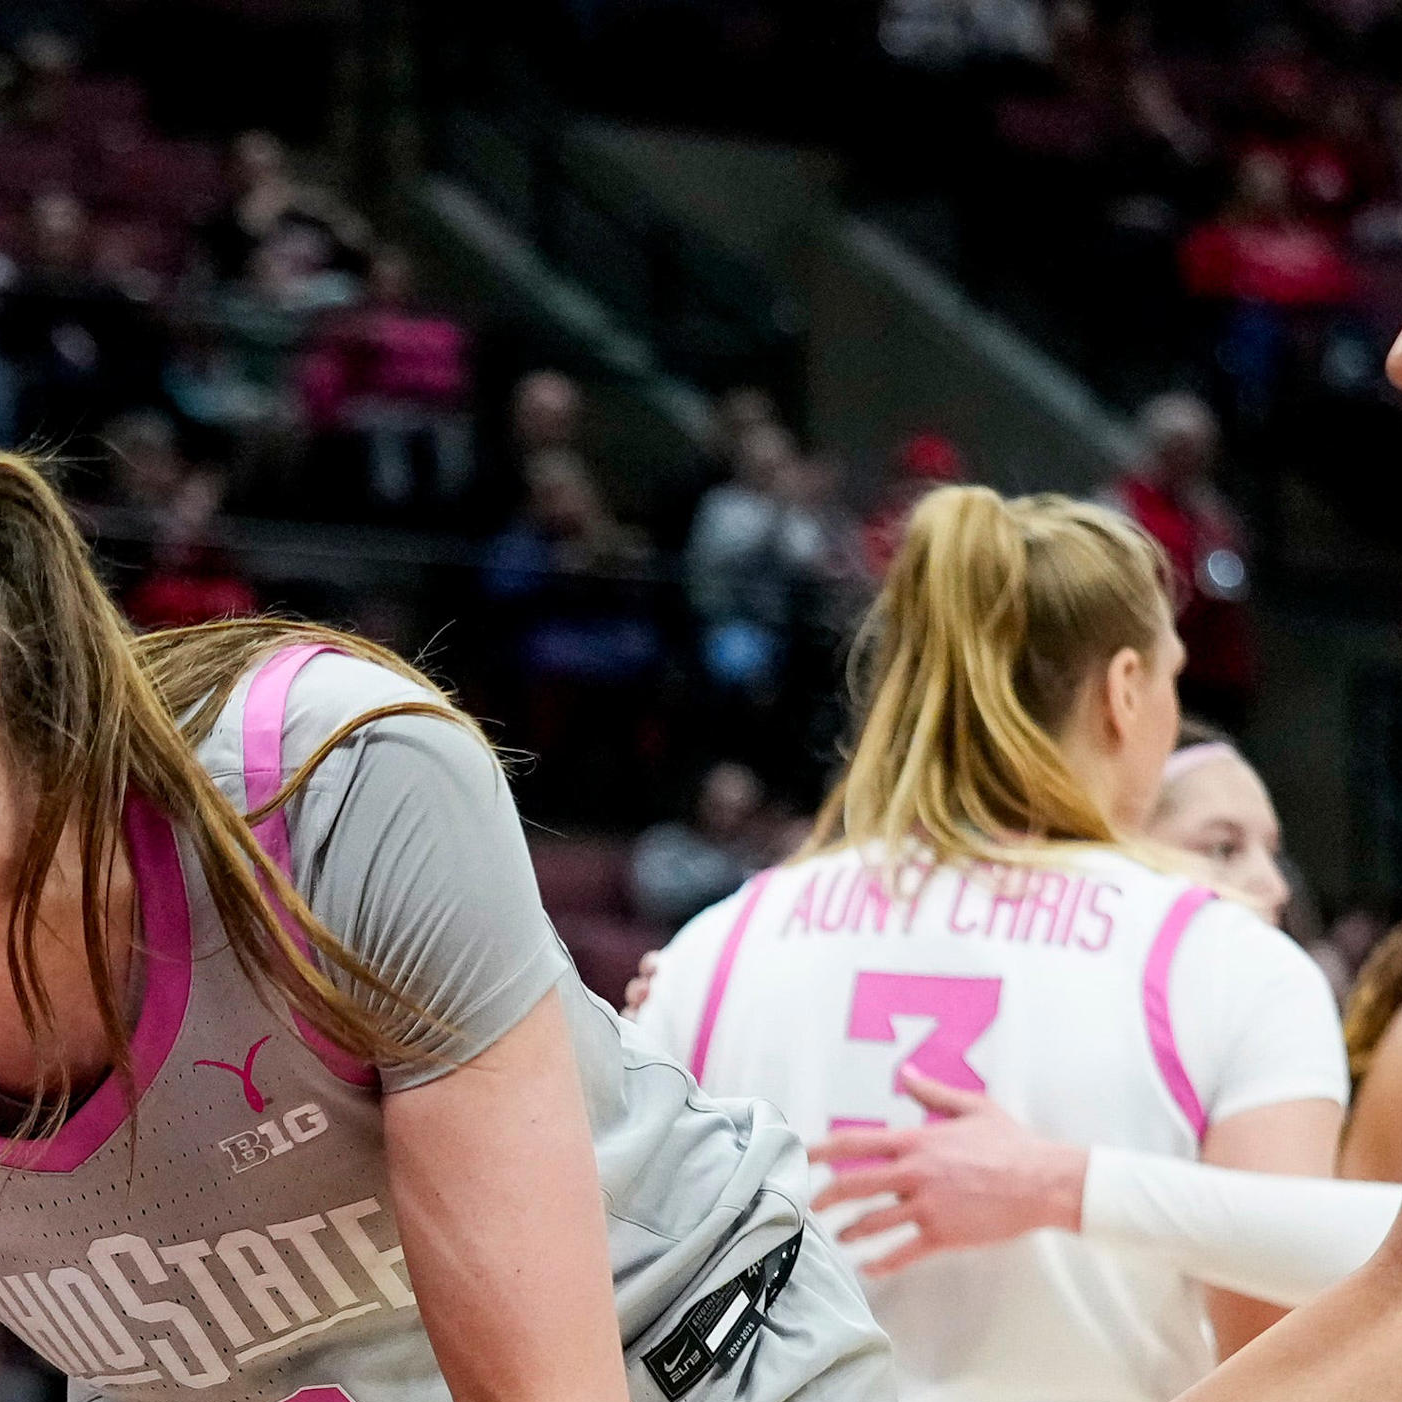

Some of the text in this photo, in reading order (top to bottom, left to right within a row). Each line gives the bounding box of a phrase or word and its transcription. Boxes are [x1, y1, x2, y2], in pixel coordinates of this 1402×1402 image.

[948, 861, 1122, 953] CHRIS
[827, 972, 1003, 1176] 3
[86, 1197, 417, 1389] STATE
